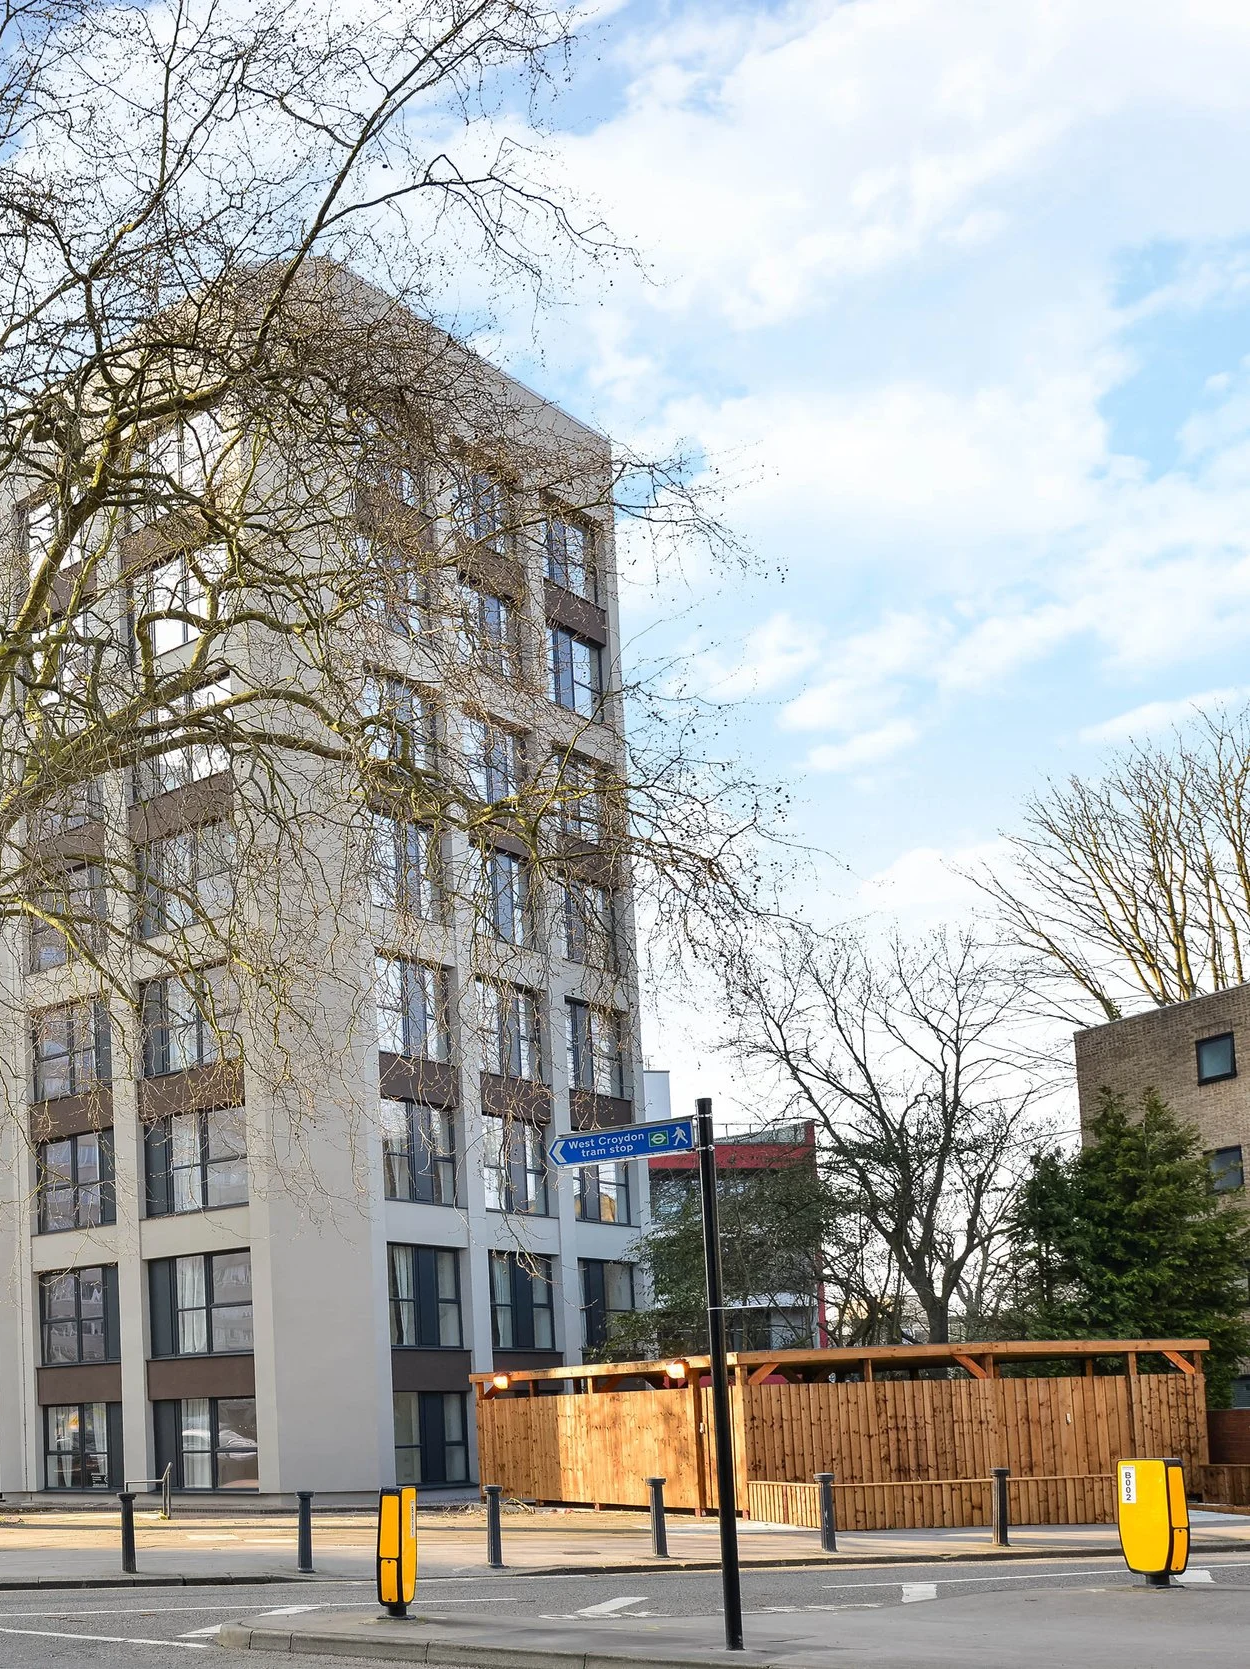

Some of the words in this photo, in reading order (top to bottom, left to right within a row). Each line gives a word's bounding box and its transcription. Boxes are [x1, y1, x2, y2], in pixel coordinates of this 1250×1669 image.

[568, 1139, 595, 1149] West
[598, 1133, 644, 1145] Croydon
[581, 1148, 606, 1157] tram
[609, 1144, 634, 1153] stop
[1124, 1471, 1132, 1501] B002
